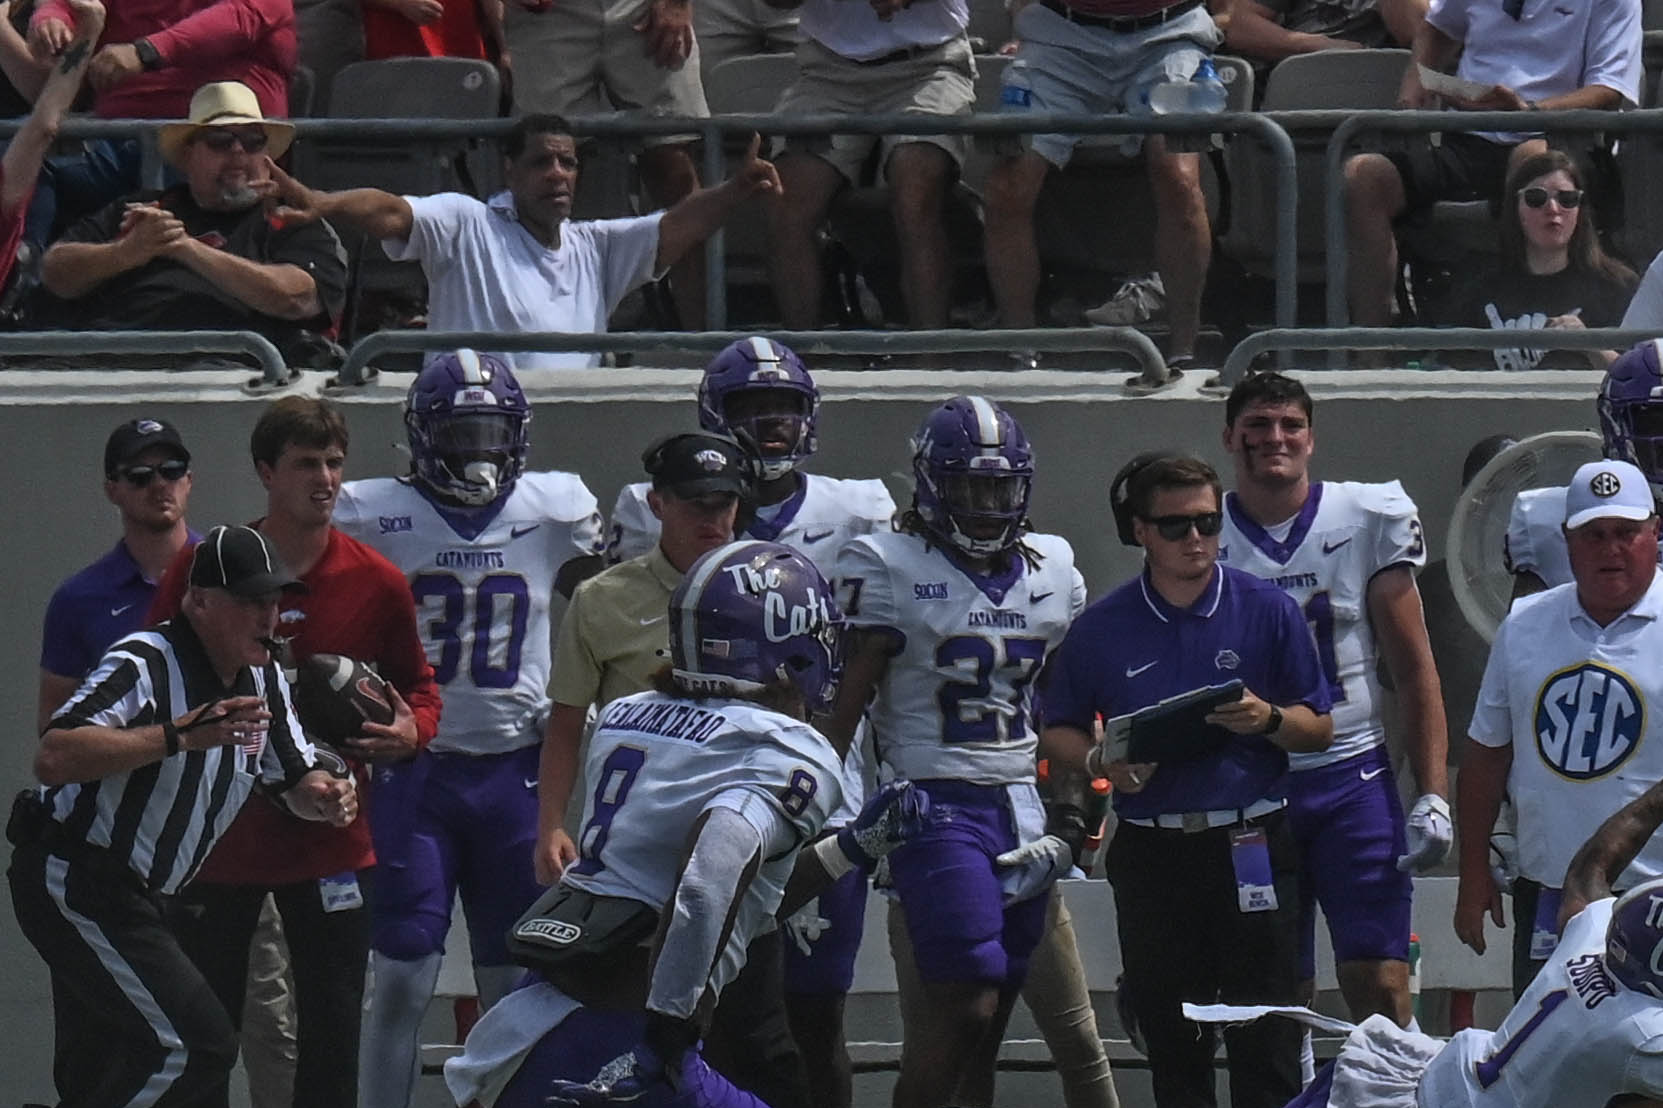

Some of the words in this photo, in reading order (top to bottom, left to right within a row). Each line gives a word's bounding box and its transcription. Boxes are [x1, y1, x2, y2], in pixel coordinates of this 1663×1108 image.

[1592, 474, 1620, 495] SEC
[436, 551, 504, 568] CATAMOUNTS
[722, 563, 782, 595] The
[411, 573, 530, 688] 30
[935, 635, 1049, 744] 27
[1540, 668, 1637, 773] SEC
[566, 744, 647, 877] 8
[780, 768, 819, 817] 8
[1475, 988, 1570, 1090] 1
